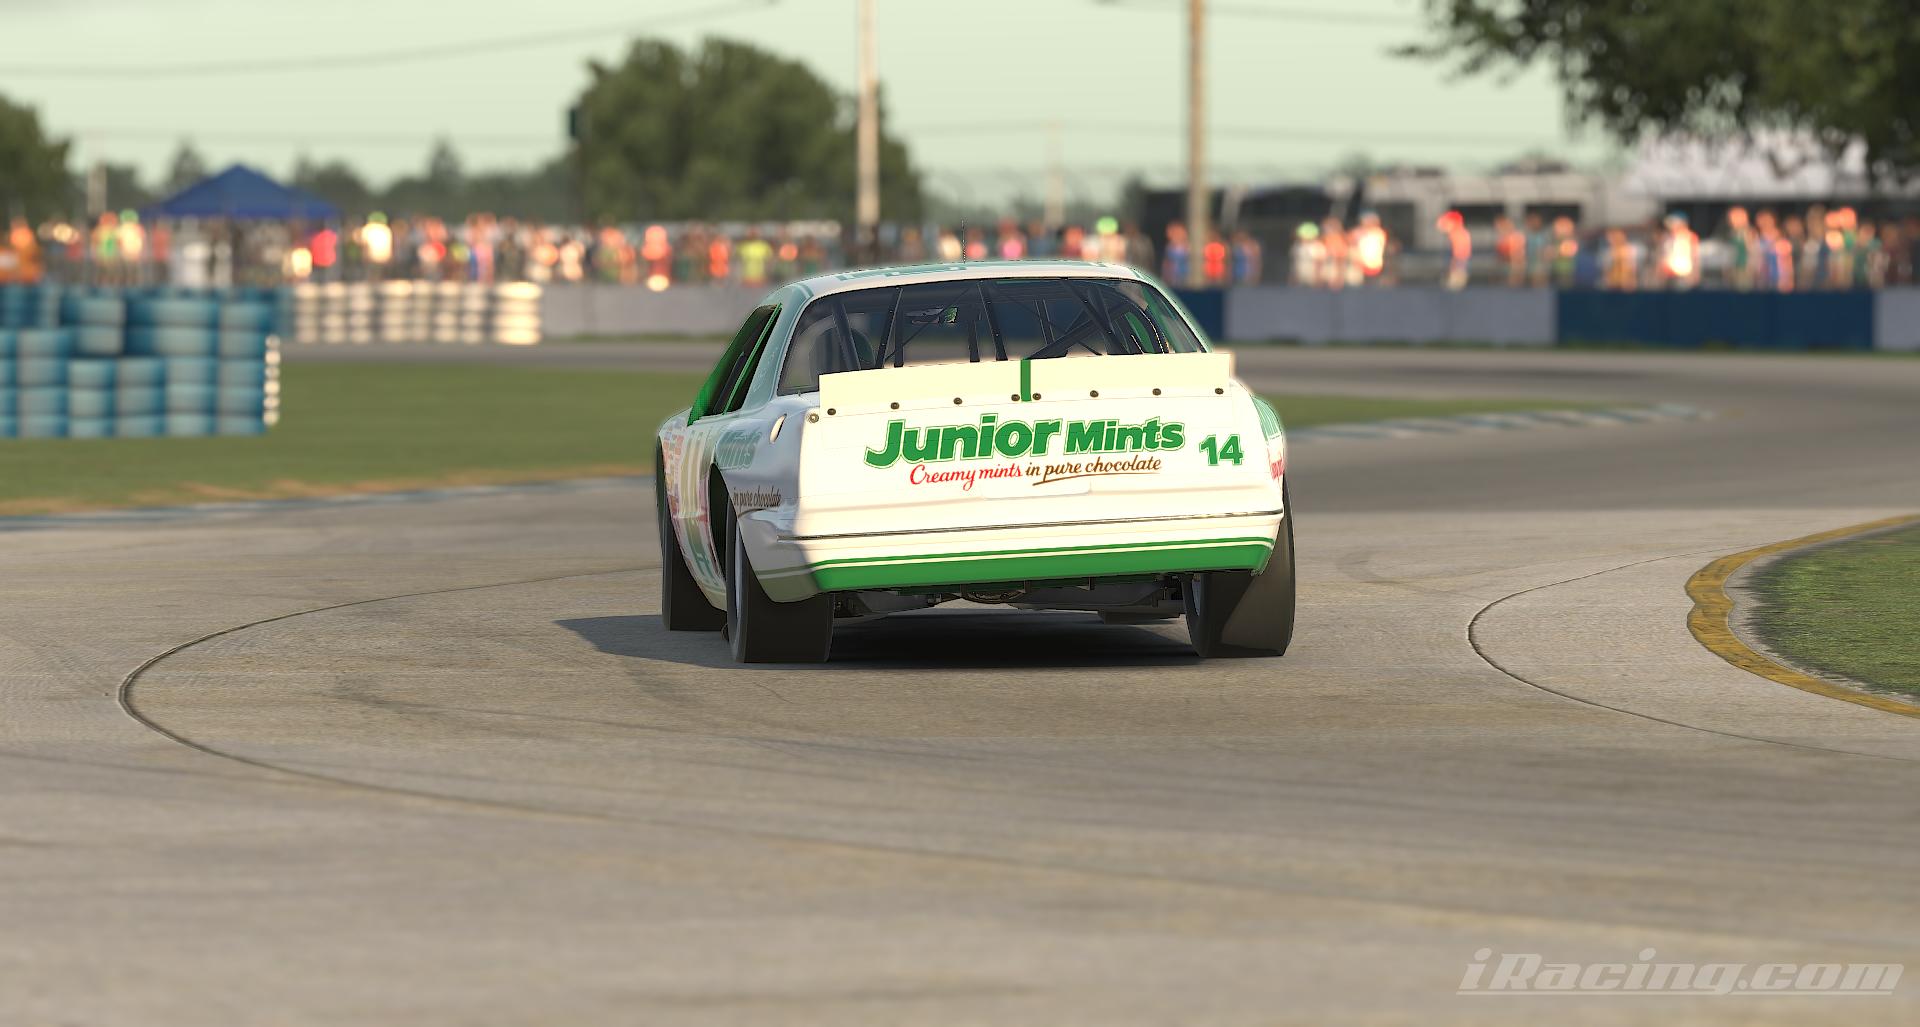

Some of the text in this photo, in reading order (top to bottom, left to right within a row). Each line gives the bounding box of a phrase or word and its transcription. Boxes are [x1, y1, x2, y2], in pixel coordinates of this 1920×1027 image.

[864, 413, 1185, 469] Junior Mints
[1199, 434, 1244, 466] 14
[910, 455, 1162, 491] Creamy mints in pure chocolate
